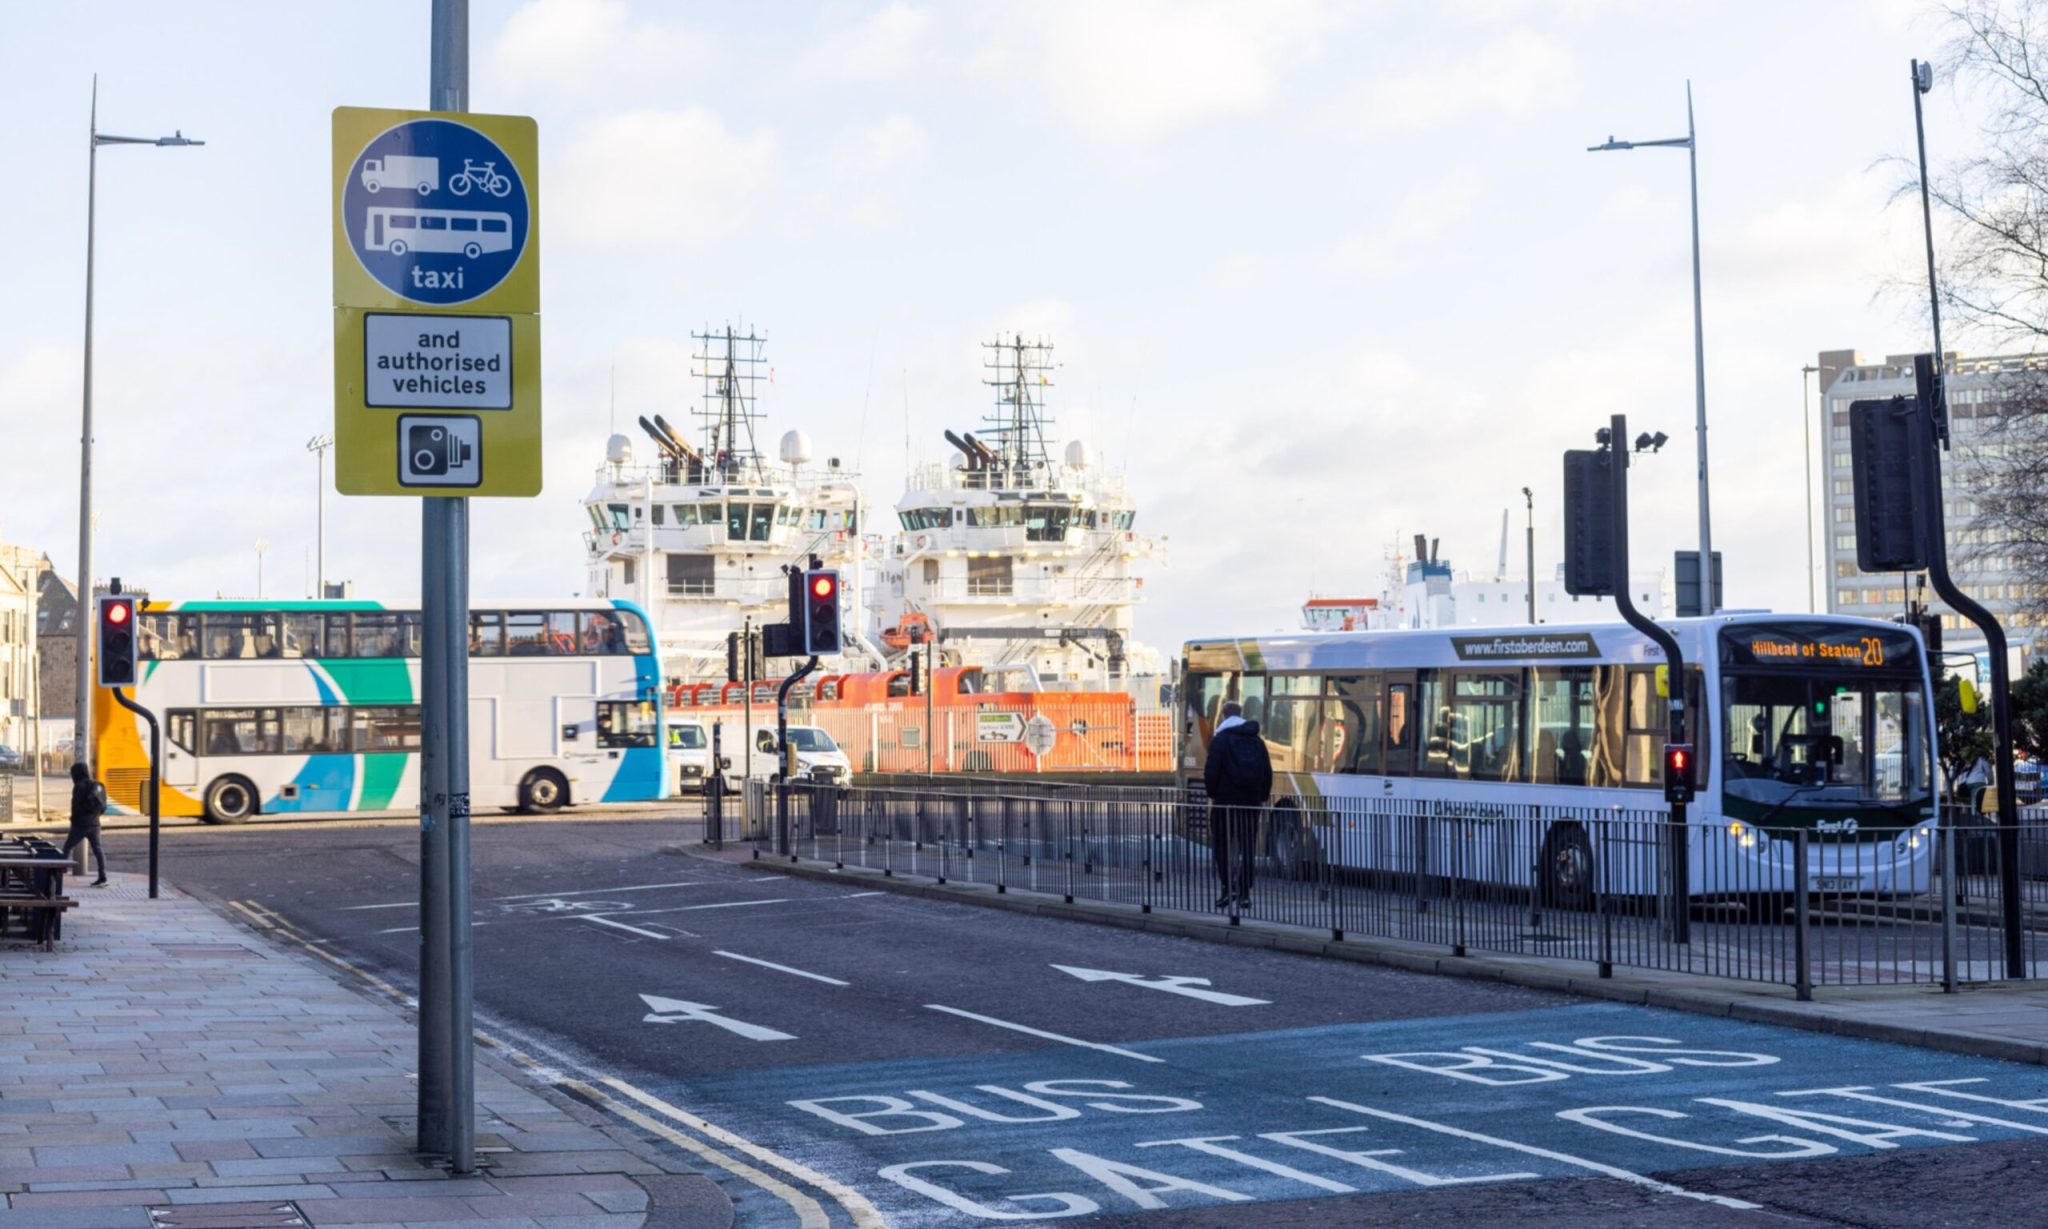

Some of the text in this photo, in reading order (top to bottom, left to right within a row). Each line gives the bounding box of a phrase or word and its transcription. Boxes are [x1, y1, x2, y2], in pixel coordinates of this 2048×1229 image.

[411, 265, 464, 289] taxi
[418, 330, 460, 349] and
[377, 352, 500, 373] authorised
[393, 374, 486, 395] vehicles
[1802, 642, 1815, 657] of
[1819, 643, 1861, 658] Seaton
[1861, 636, 1883, 666] 20
[1360, 1036, 1781, 1086] BUS
[785, 1079, 1205, 1136] BUS
[878, 1126, 1543, 1220] GATE
